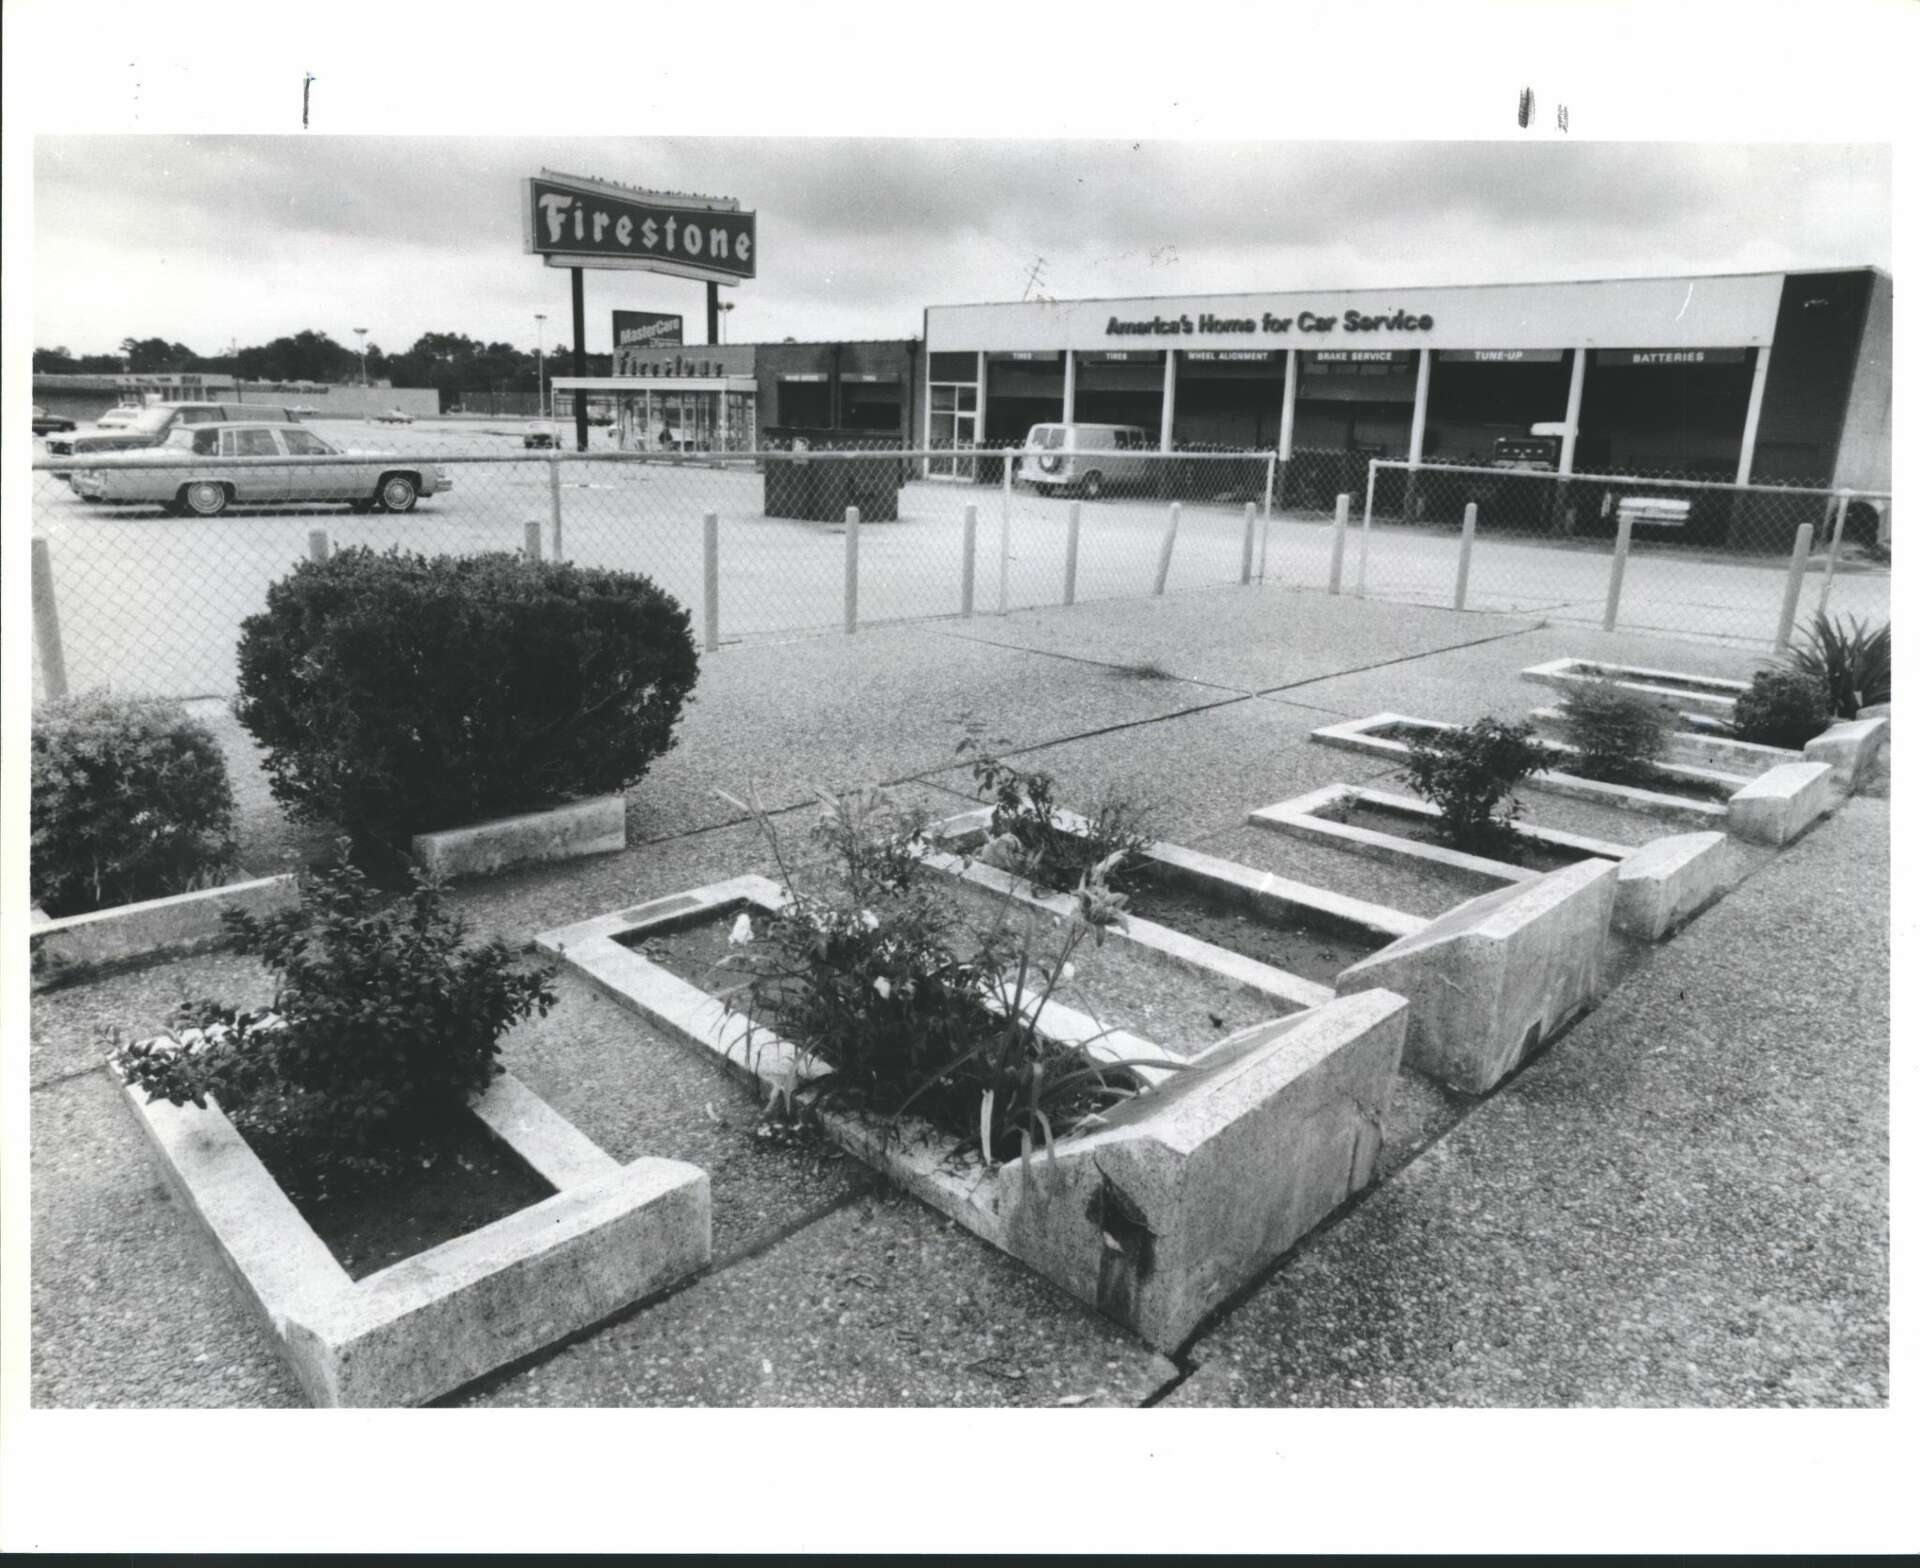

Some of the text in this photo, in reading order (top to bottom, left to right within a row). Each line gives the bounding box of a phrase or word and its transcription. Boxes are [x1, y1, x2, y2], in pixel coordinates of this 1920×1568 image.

[538, 193, 751, 261] Firestone
[1105, 309, 1434, 336] America's Home for Car Service
[1187, 351, 1269, 361] WHEEL ALIGNMENT
[1317, 351, 1393, 361] BRAKE SERVICE
[1474, 350, 1523, 361] TUNE-UP
[1632, 351, 1705, 363] BATTERIES
